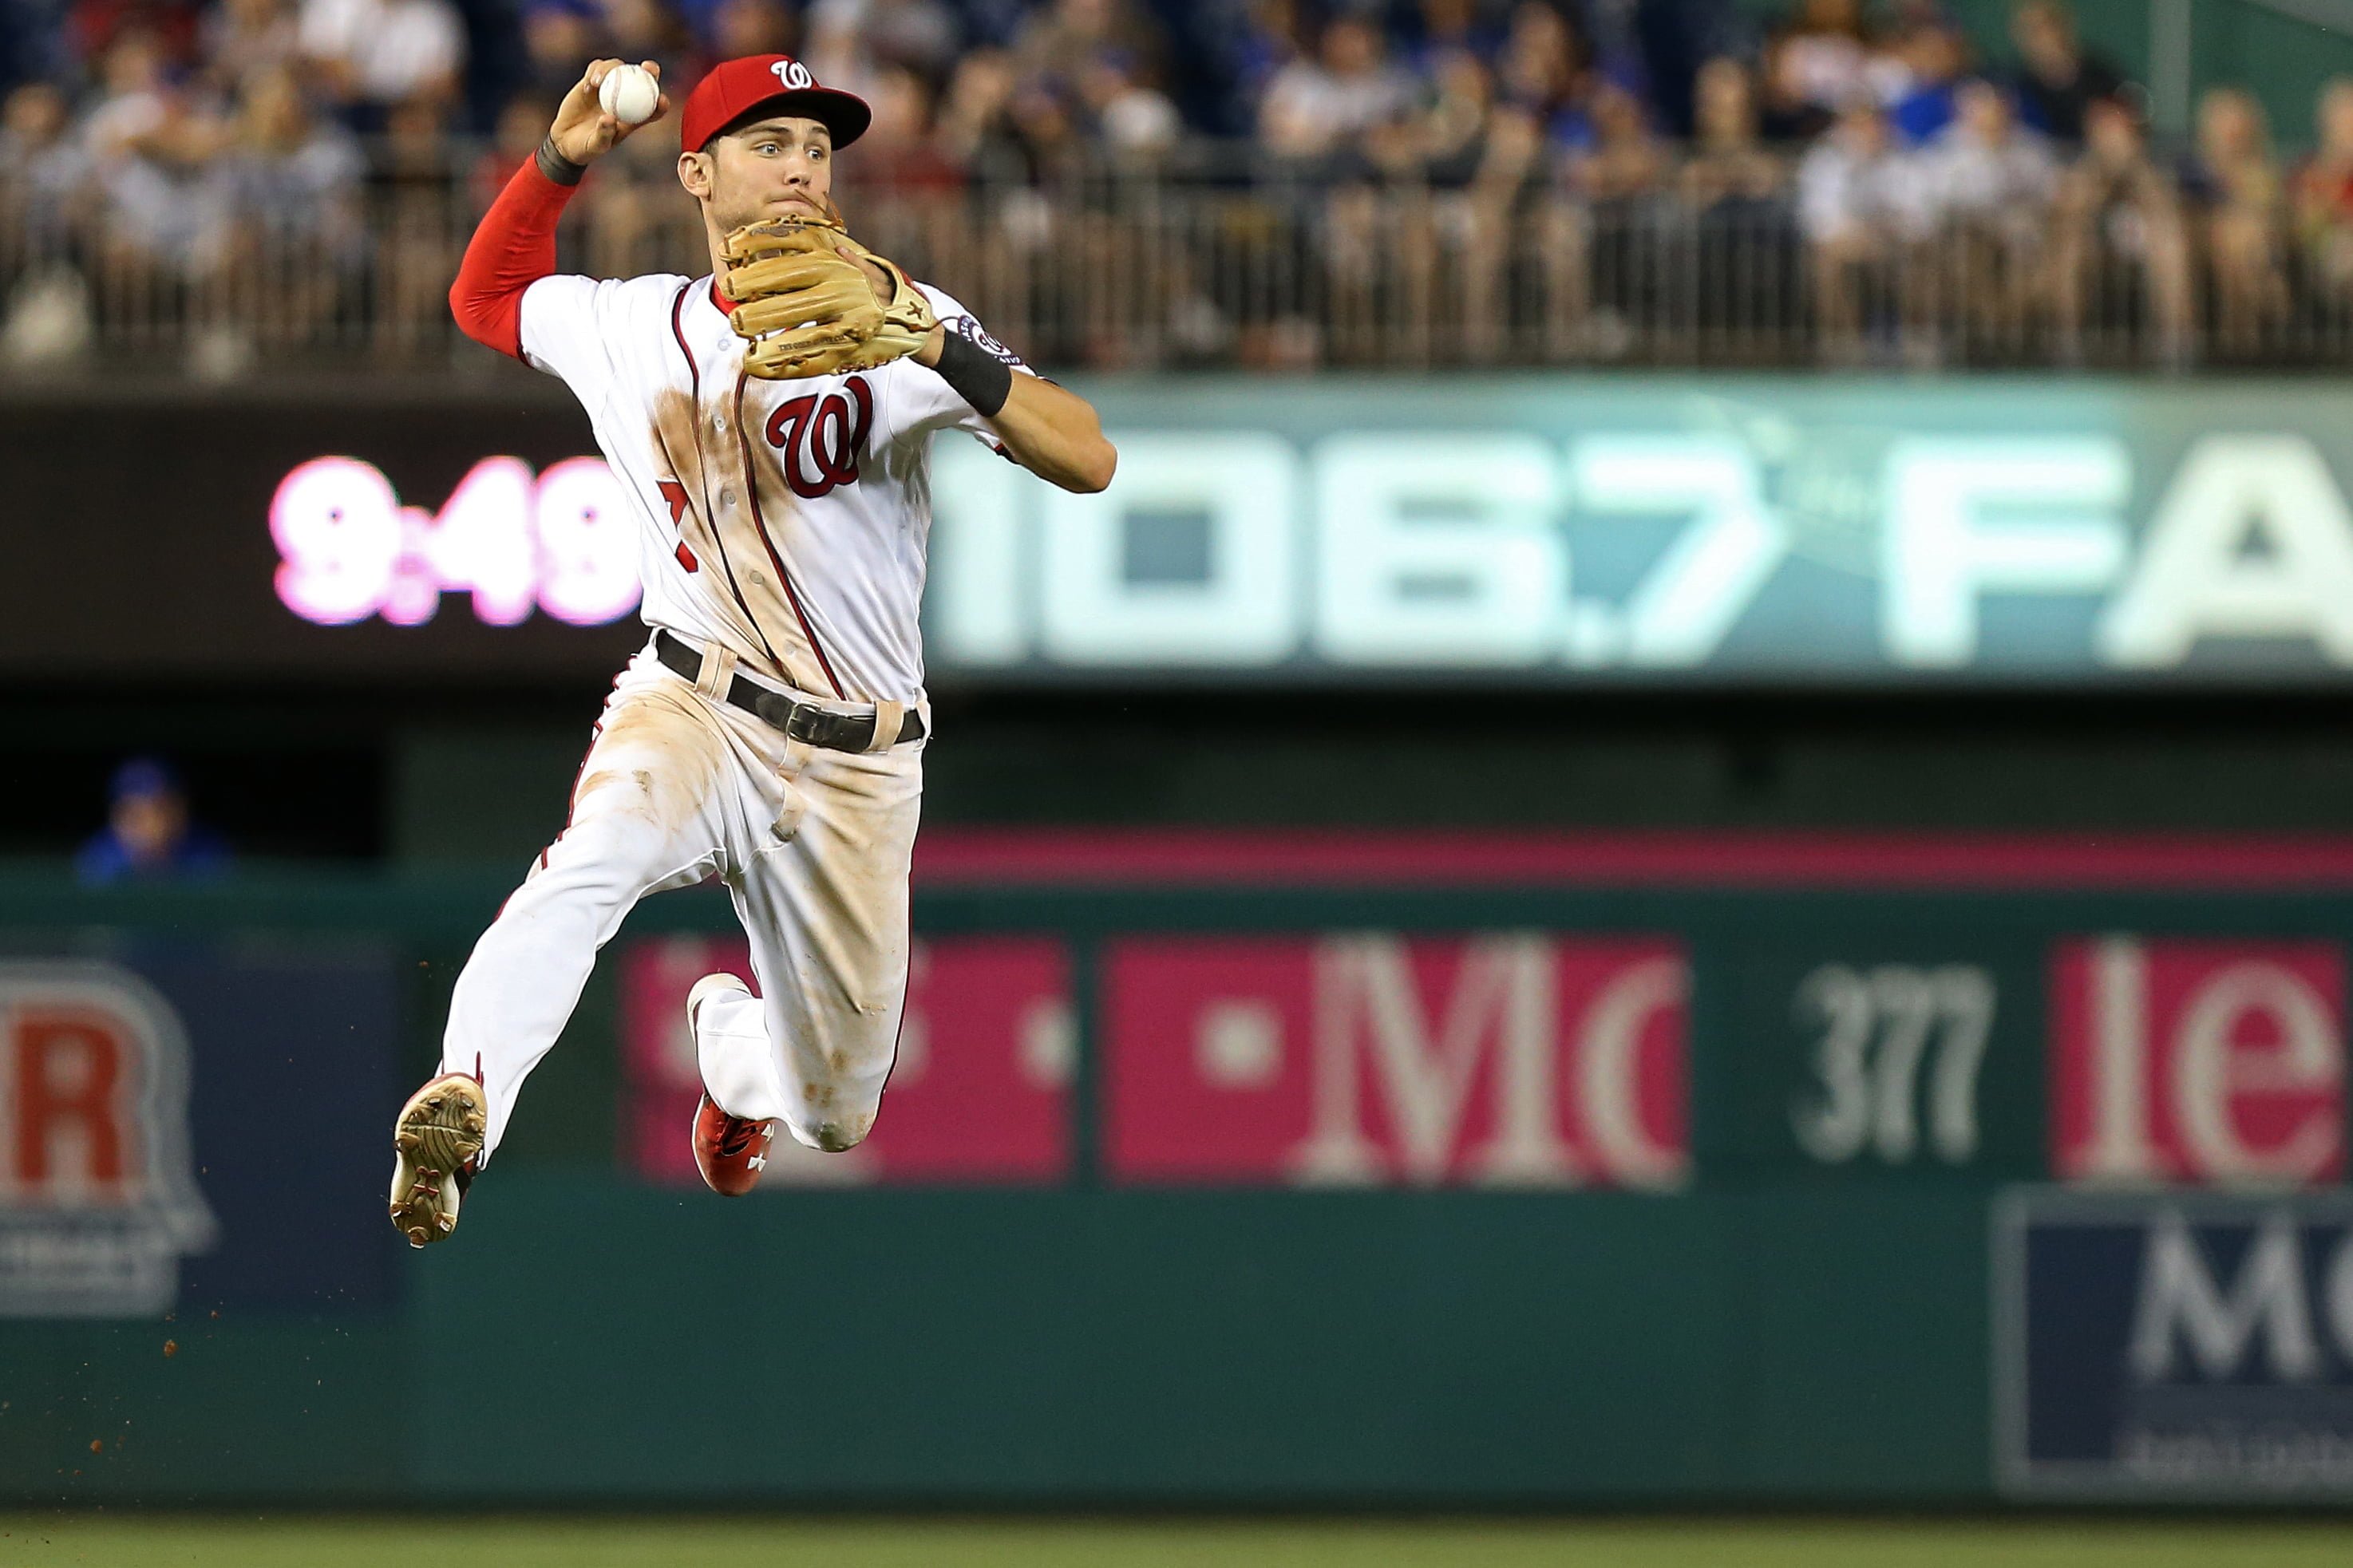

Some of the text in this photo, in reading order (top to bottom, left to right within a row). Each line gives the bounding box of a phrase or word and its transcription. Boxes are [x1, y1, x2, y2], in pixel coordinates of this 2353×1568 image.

[769, 60, 813, 90] W
[765, 376, 874, 499] W
[269, 455, 640, 626] 9:49
[940, 431, 2353, 667] 106.7 FA
[1790, 964, 1995, 1165] 377
[2130, 1209, 2353, 1379] M
